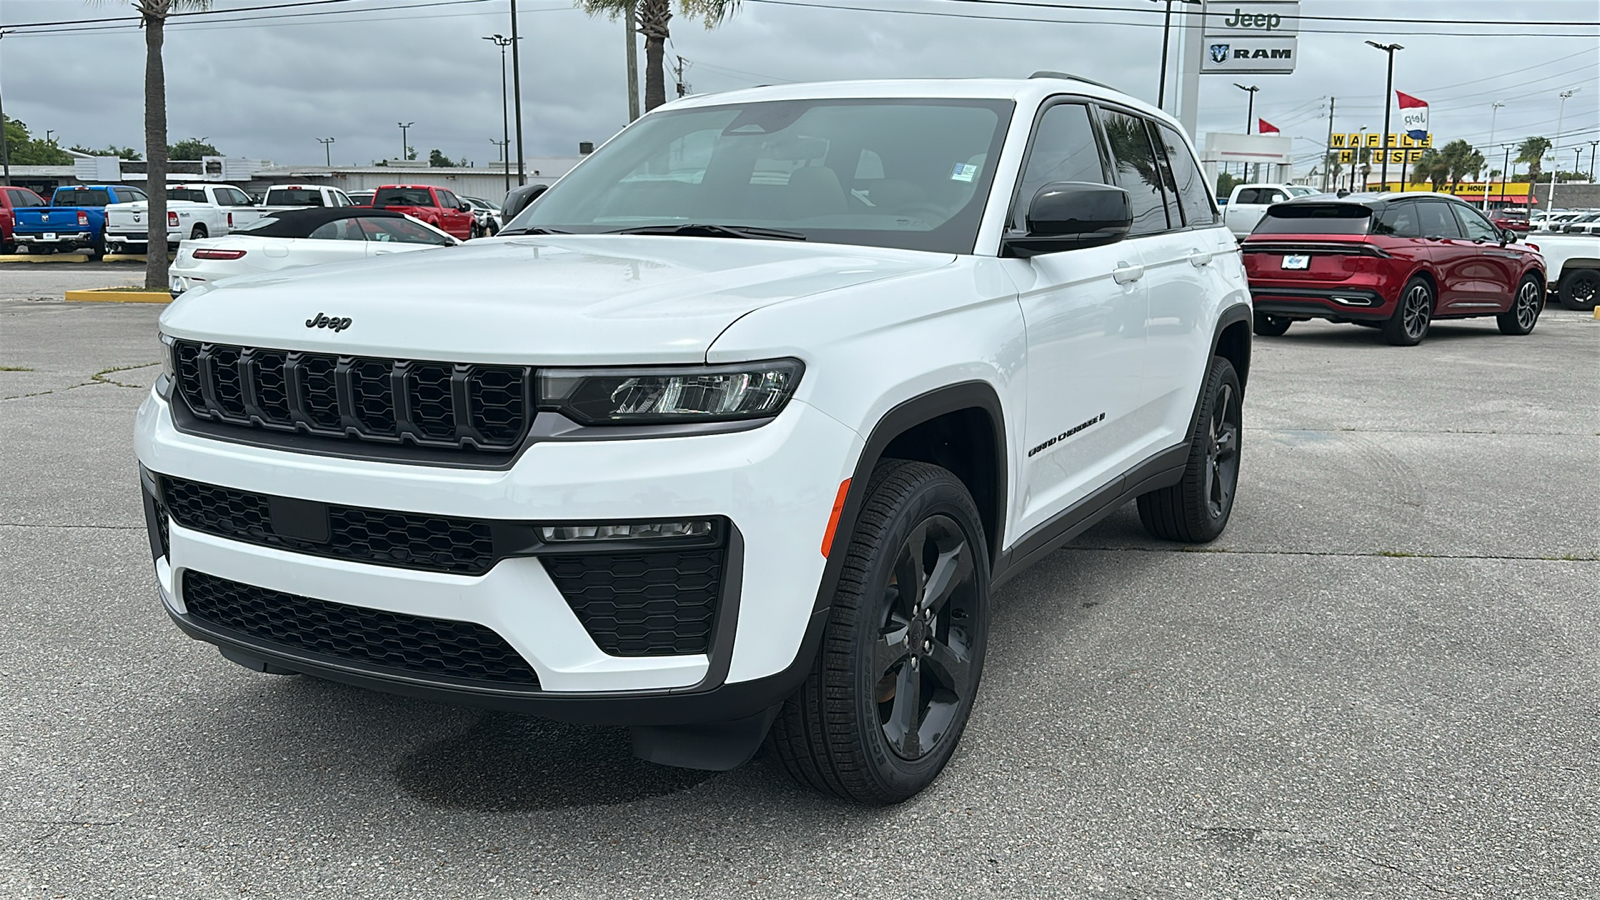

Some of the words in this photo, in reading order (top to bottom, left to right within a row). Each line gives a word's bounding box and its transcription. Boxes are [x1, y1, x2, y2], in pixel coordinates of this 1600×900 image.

[1225, 8, 1281, 31] Jeep
[1233, 49, 1292, 59] RAM
[1333, 135, 1430, 146] WAFFLE
[1341, 152, 1420, 162] HUSE
[305, 312, 353, 333] Jeep
[1028, 437, 1057, 457] GRAND
[1058, 416, 1099, 441] CHEROKEE
